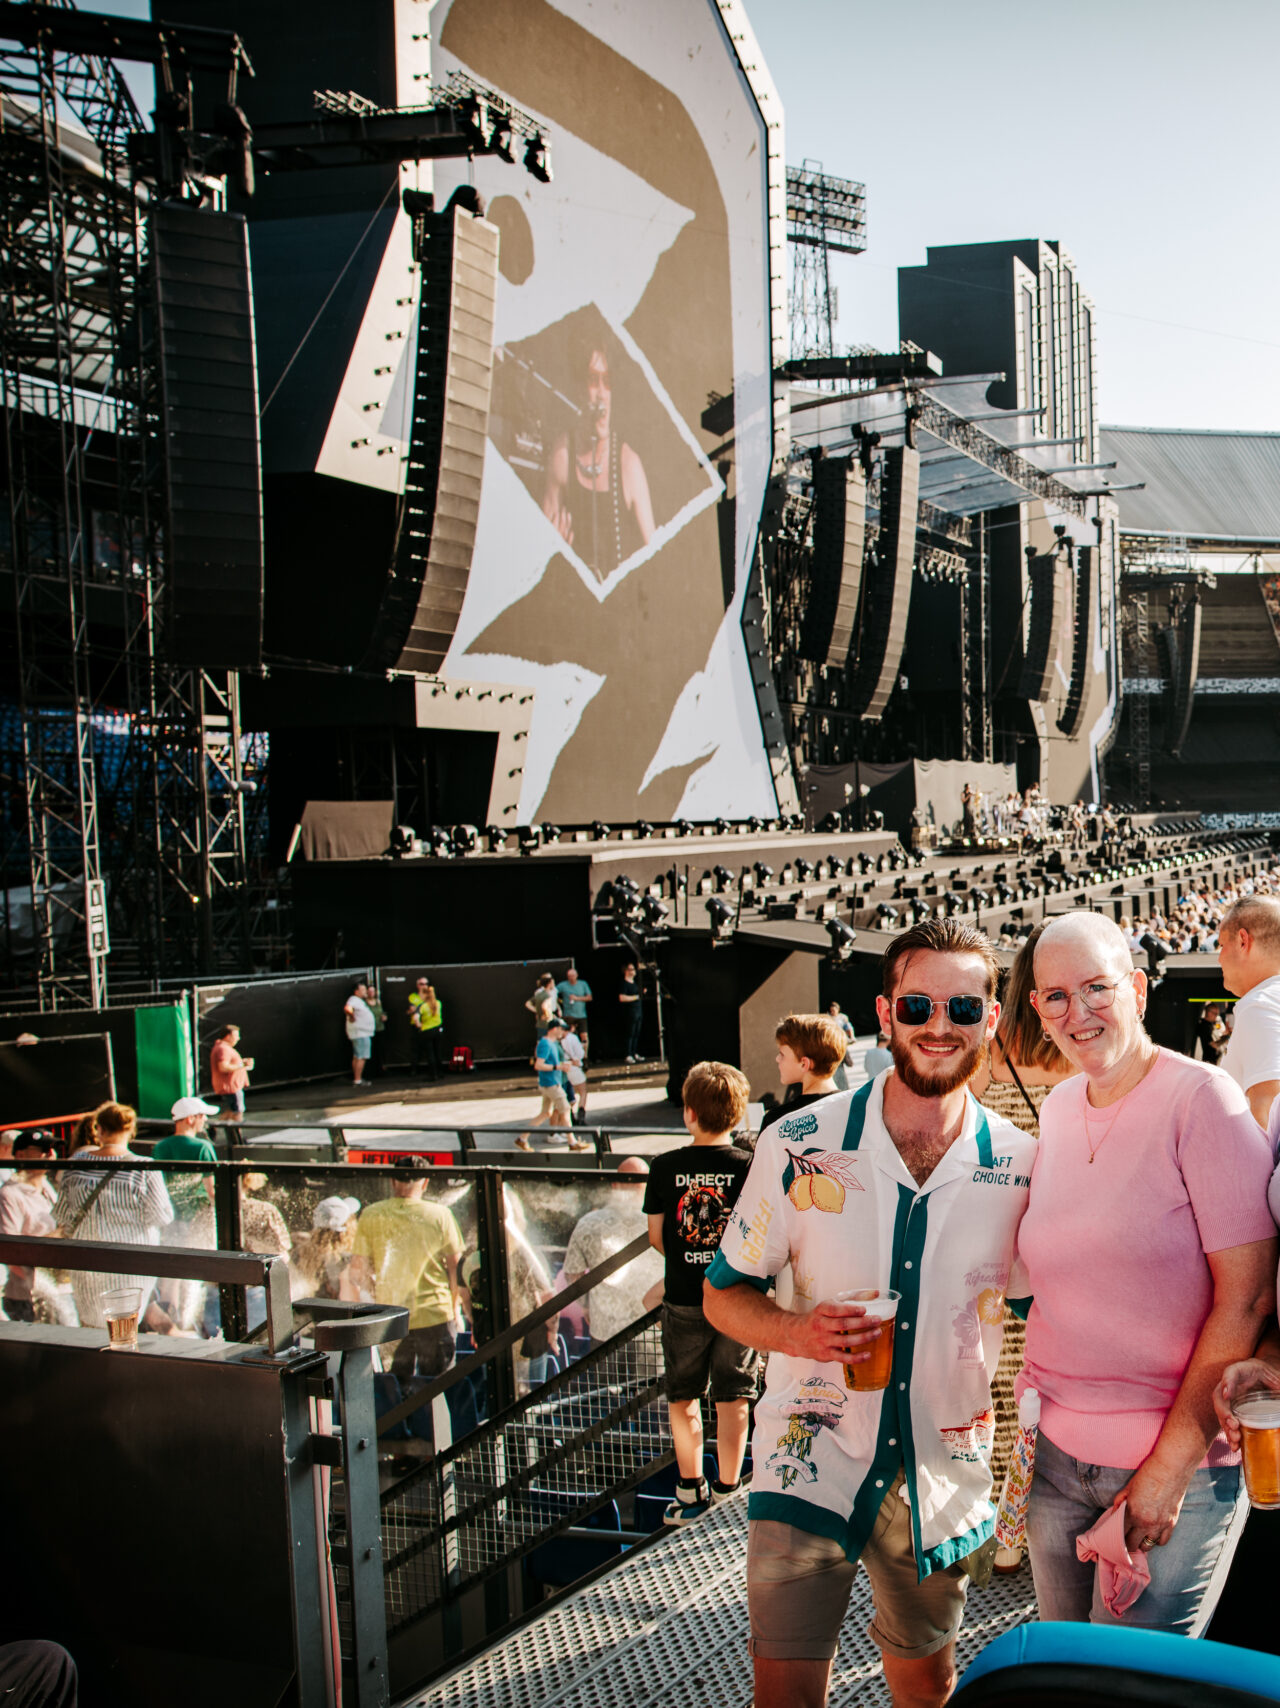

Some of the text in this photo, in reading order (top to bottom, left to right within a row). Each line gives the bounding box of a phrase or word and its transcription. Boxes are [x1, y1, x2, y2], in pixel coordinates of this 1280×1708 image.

[992, 1156, 1013, 1168] AFT
[973, 1170, 1031, 1188] CHOICE WIN
[684, 1251, 718, 1264] CRE
